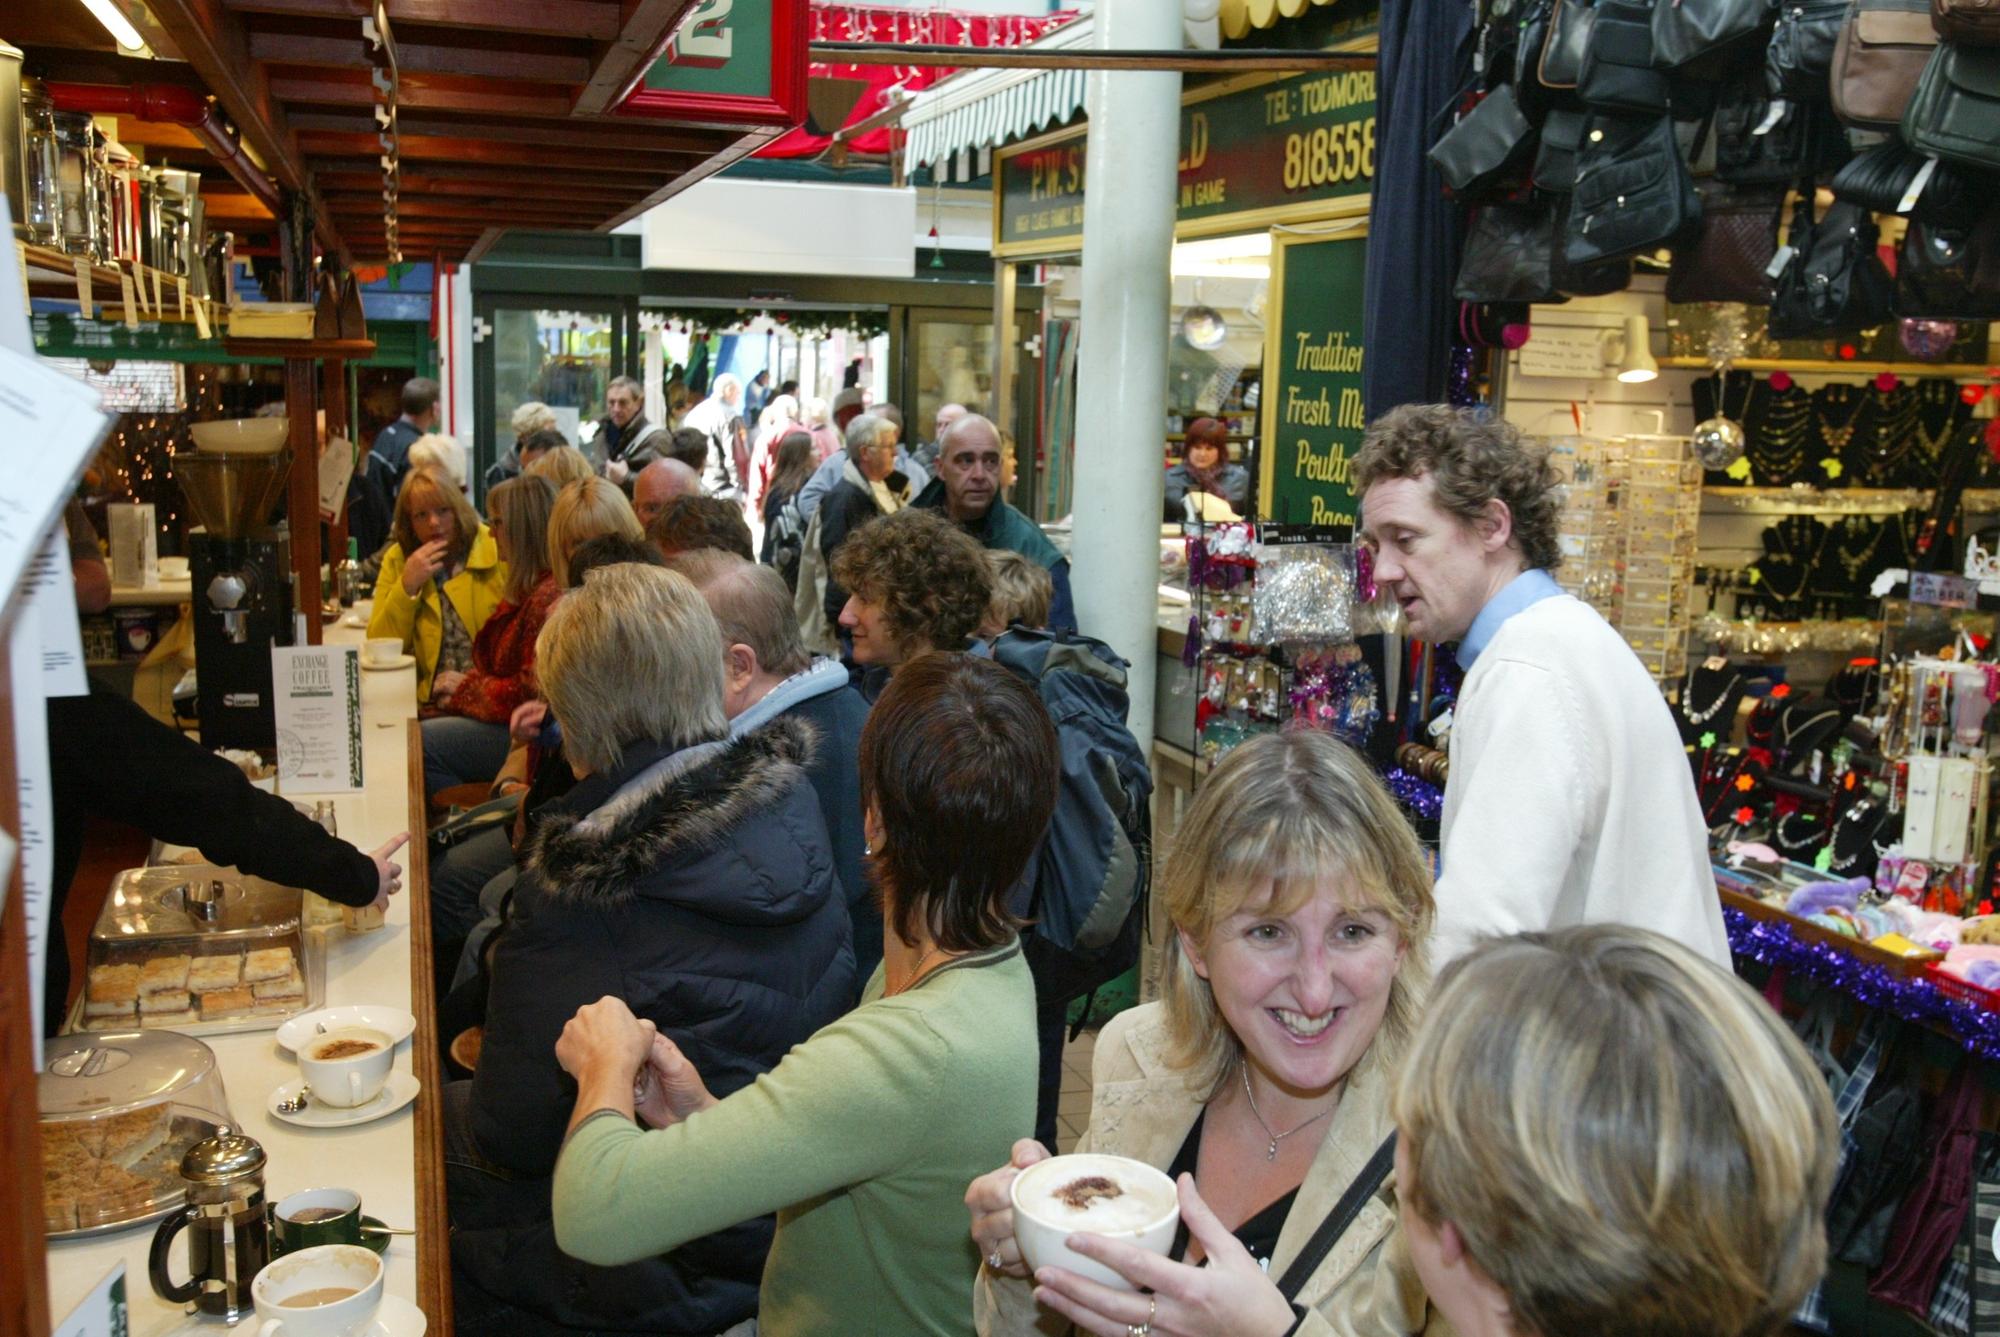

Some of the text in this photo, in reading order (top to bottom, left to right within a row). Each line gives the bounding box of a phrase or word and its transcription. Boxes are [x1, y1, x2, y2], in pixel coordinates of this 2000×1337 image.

[1195, 178, 1226, 206] GAME
[1286, 386, 1331, 426] Fresh
[1279, 535, 1308, 543] TINSEL
[292, 655, 329, 670] EXCHANGE
[292, 670, 331, 685] COFFEE
